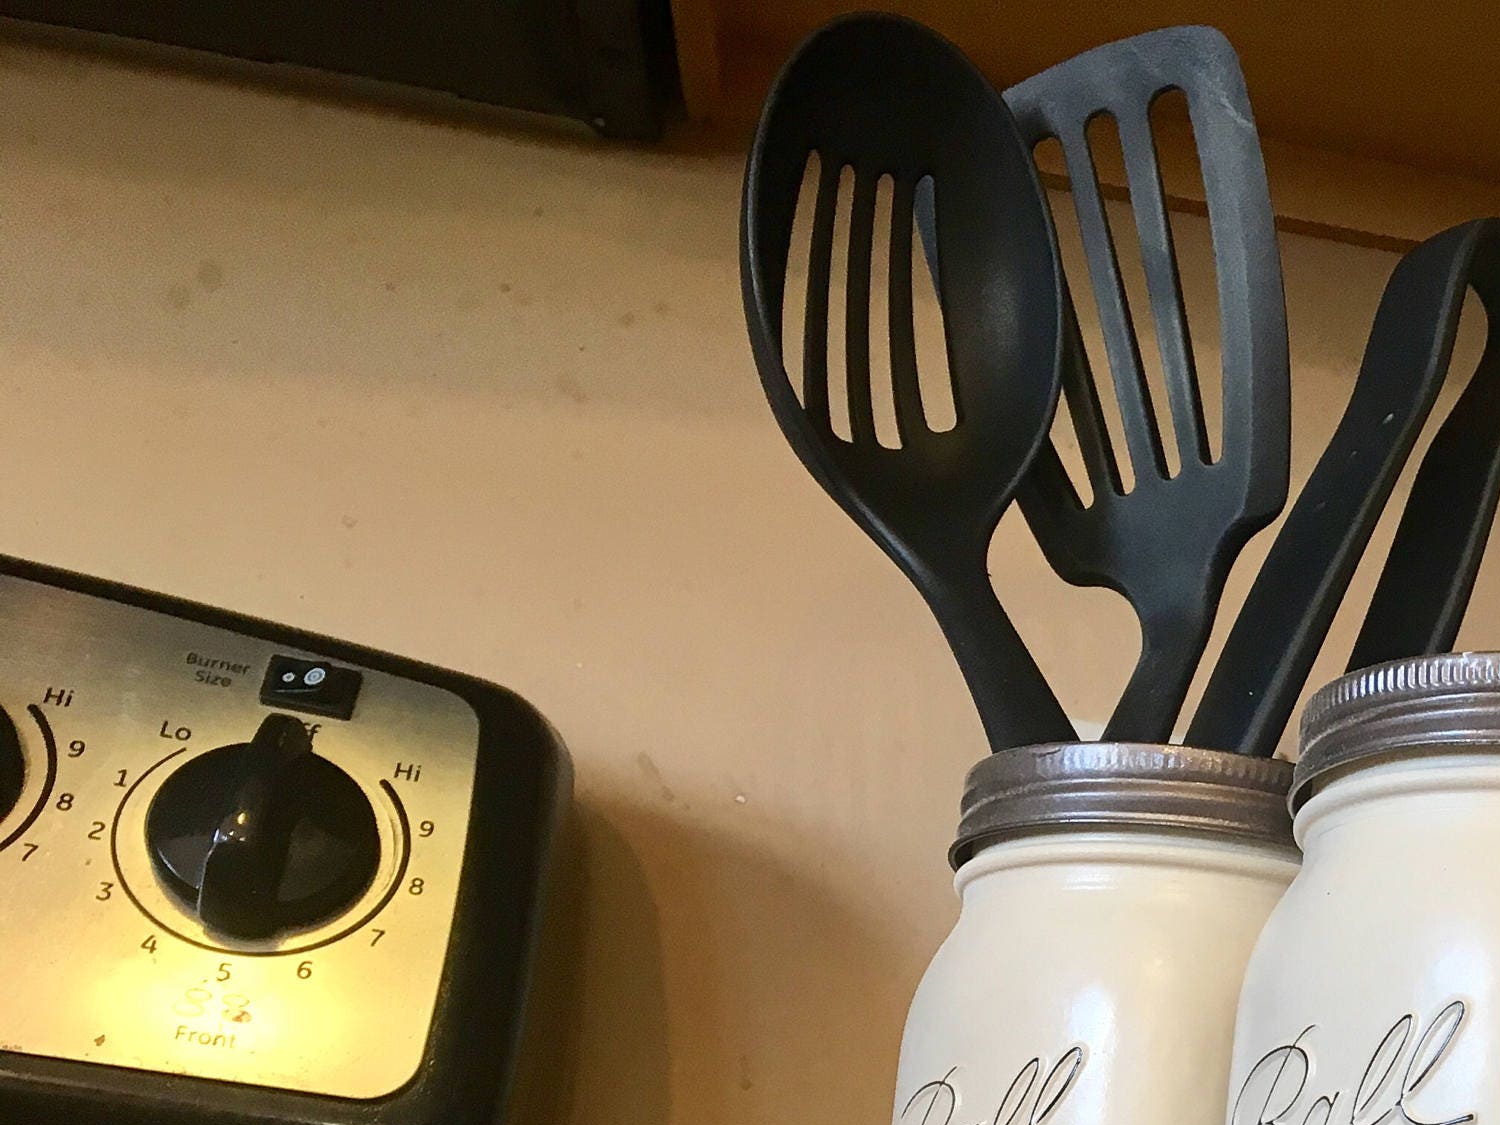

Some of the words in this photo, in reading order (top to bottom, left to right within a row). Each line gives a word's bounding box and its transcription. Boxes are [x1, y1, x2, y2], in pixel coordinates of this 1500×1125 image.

[186, 652, 251, 676] Burner
[195, 671, 232, 688] Size
[43, 687, 75, 707] Hi
[160, 720, 192, 741] Lo
[68, 740, 86, 758] 9
[113, 769, 128, 787] 1
[394, 762, 423, 783] Hi
[56, 793, 74, 811] 8
[87, 821, 106, 841] 2
[418, 821, 435, 838] 9
[22, 843, 39, 862] 7
[96, 882, 113, 901] 3
[409, 878, 424, 895] 8
[140, 935, 157, 955] 4
[369, 929, 386, 948] 7
[217, 963, 231, 982] 5
[297, 961, 313, 980] 6
[174, 1025, 236, 1049] Front
